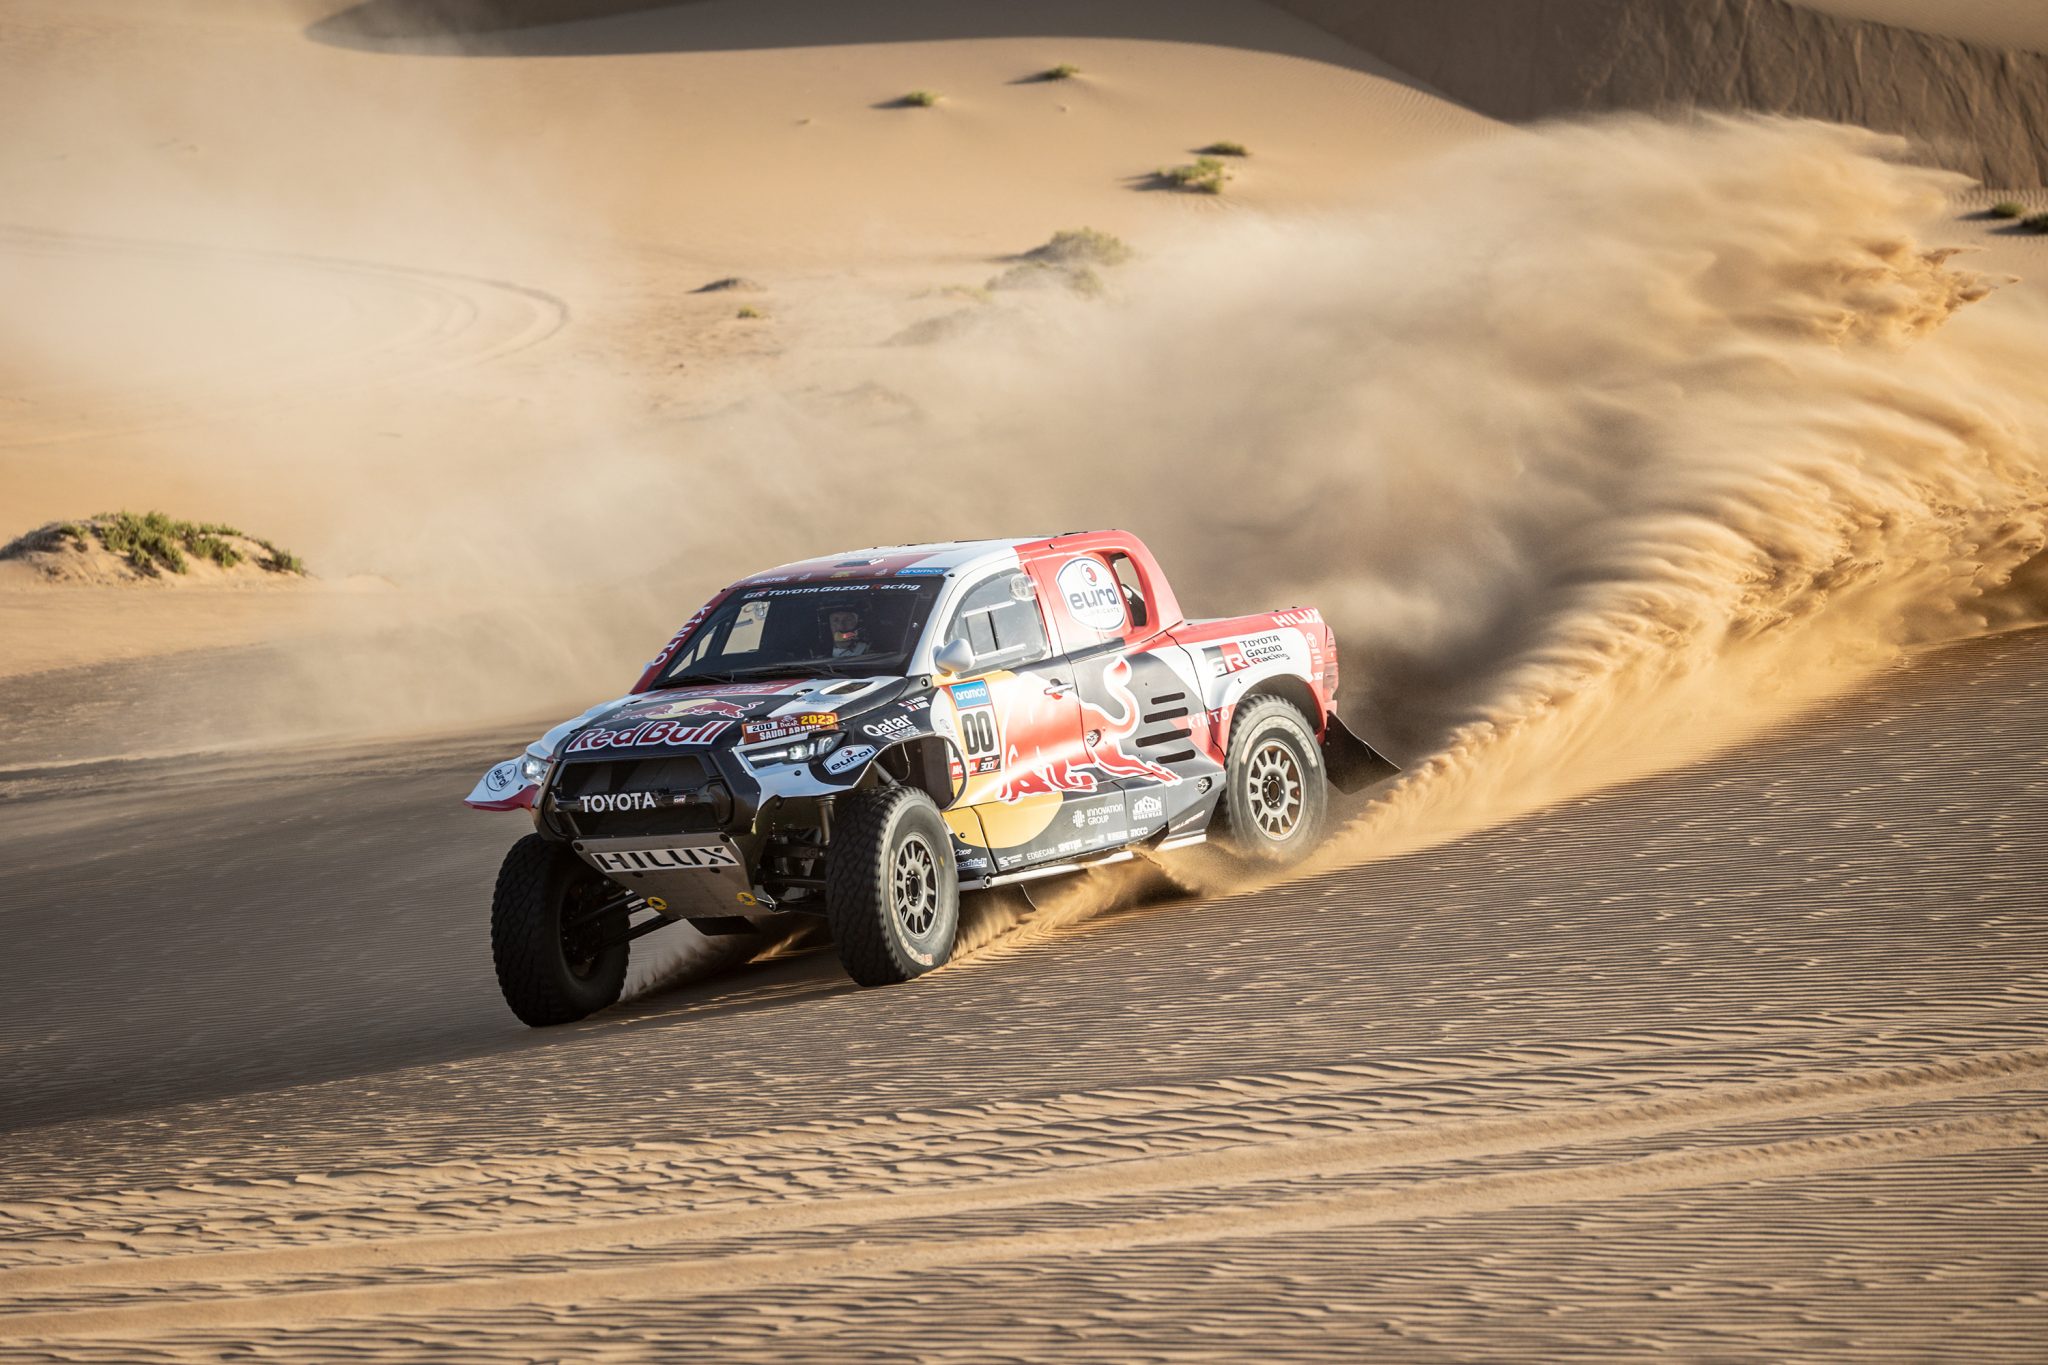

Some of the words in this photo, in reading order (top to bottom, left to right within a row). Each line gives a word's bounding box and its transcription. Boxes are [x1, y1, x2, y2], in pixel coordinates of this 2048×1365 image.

[743, 589, 768, 600] GR
[768, 587, 818, 597] TOYOTA
[820, 584, 869, 593] GAZOO
[871, 583, 921, 592] Racing
[1069, 582, 1121, 610] eurol
[1271, 608, 1323, 627] HILUX
[1239, 634, 1281, 649] TOYOTA
[1245, 644, 1283, 658] GAZOO
[1251, 651, 1291, 665] Racing
[955, 687, 987, 700] aramco
[752, 722, 773, 732] 200
[801, 714, 835, 726] 2023
[863, 714, 913, 737] Qatar
[564, 721, 651, 753] Red
[635, 720, 735, 747] Bull
[759, 728, 787, 740] SAUDI
[961, 710, 995, 755] 00
[831, 748, 873, 771] eurol
[580, 791, 657, 813] TOYOTA
[1087, 815, 1110, 825] GROUP
[593, 847, 736, 870] HILUX
